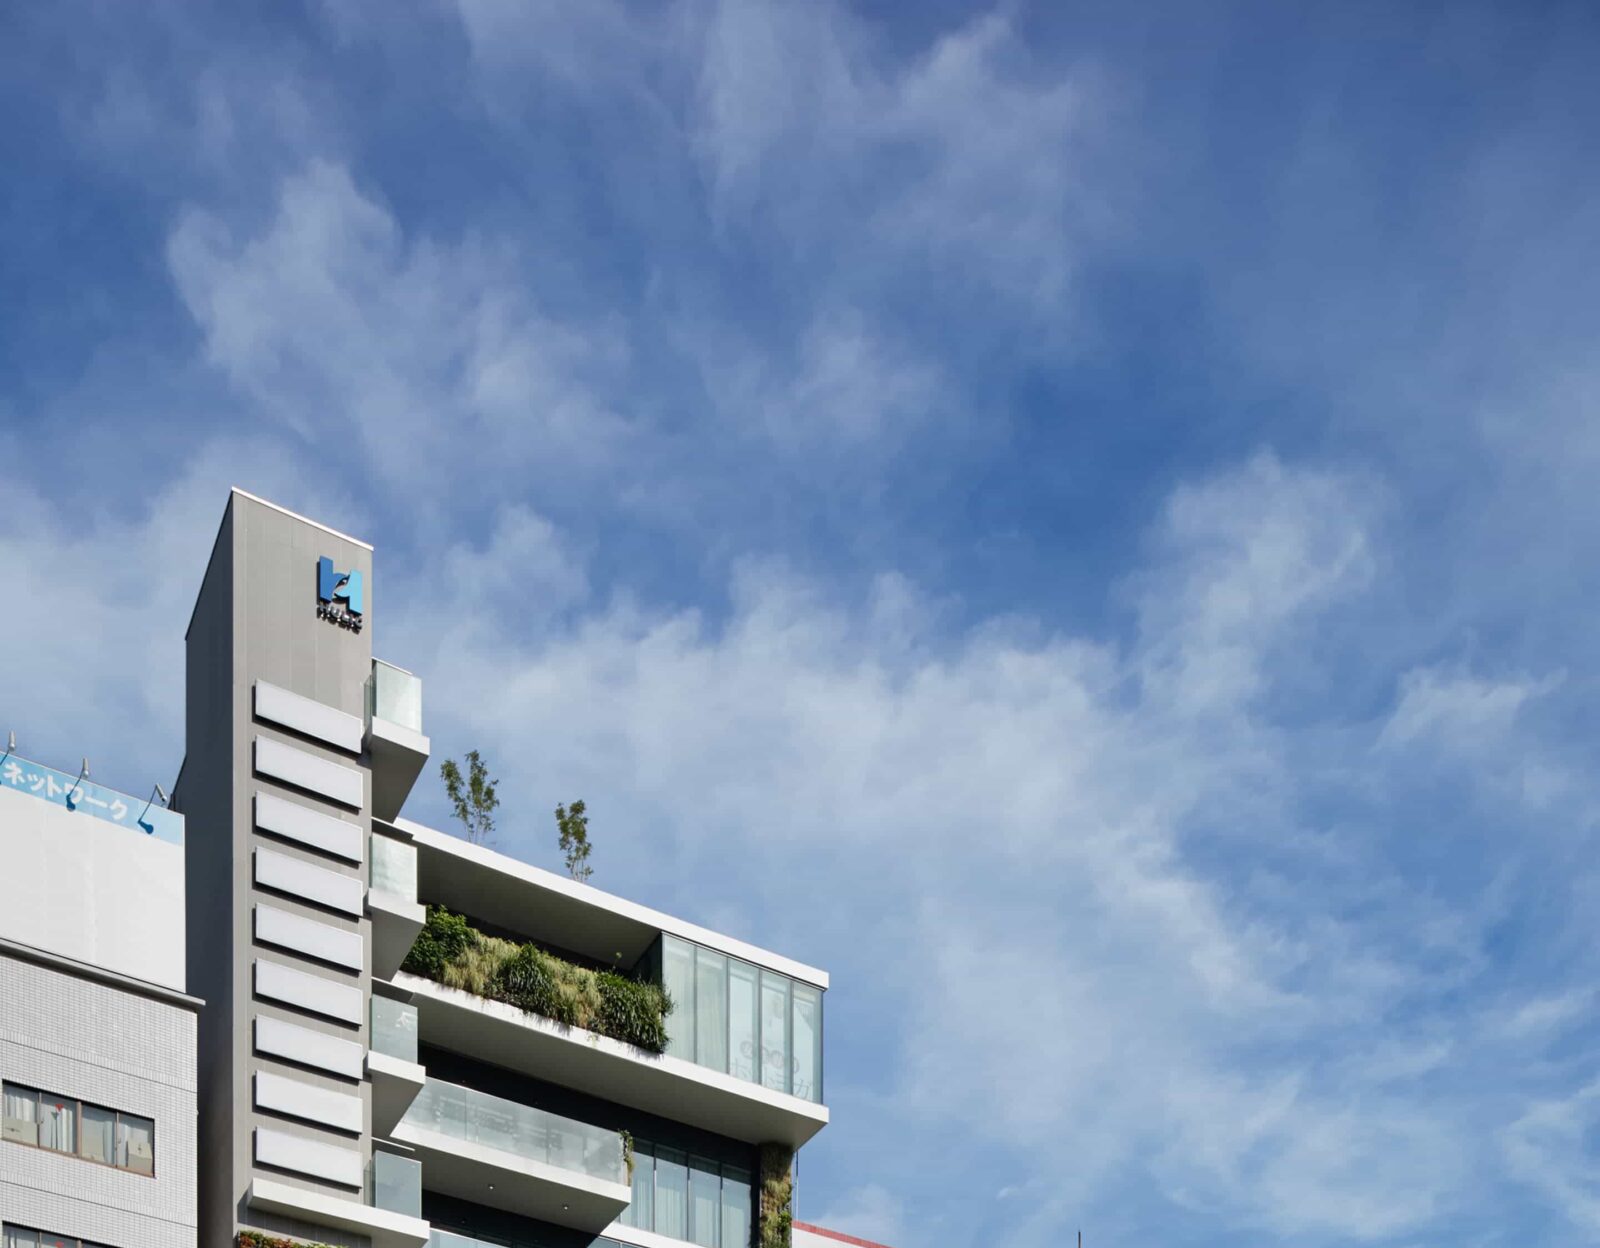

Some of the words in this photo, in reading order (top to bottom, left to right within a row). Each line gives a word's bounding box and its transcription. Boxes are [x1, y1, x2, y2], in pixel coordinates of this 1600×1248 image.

[3, 762, 128, 820] ネットワーク
